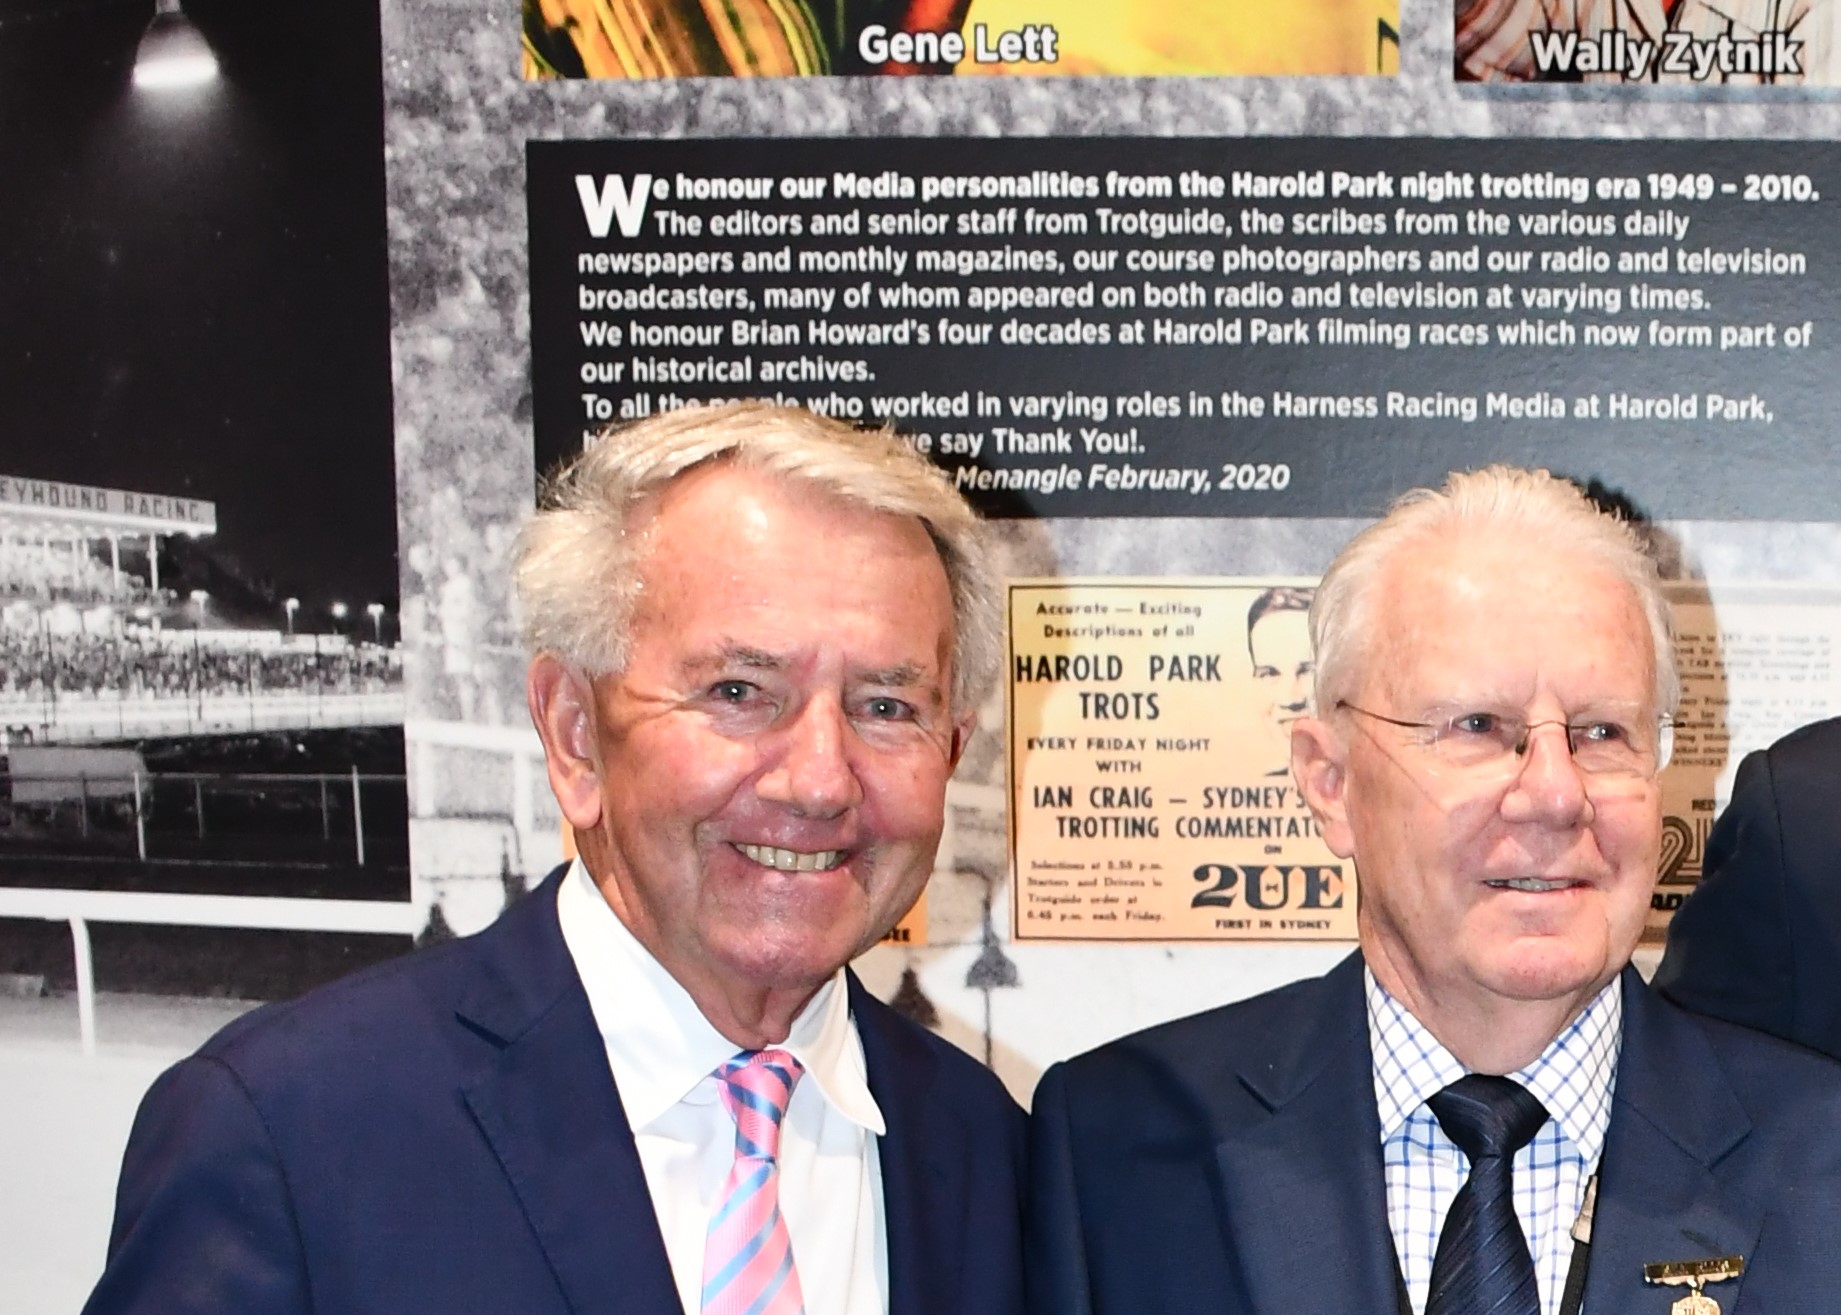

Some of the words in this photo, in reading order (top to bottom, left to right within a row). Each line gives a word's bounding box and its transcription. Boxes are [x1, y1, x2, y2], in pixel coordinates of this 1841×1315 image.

[858, 24, 964, 64] Gene
[975, 24, 1058, 63] Lett
[1529, 31, 1652, 81] Wally
[1662, 31, 1801, 81] Zytnik
[574, 172, 669, 238] We
[675, 172, 774, 200] honour
[779, 177, 828, 199] our
[833, 171, 916, 199] Media
[921, 170, 1100, 203] personalities
[1105, 170, 1173, 198] from
[1178, 170, 1226, 198] the
[1231, 170, 1325, 198] Harold
[1331, 170, 1395, 198] Park
[1400, 170, 1475, 203] night
[1479, 171, 1590, 204] trotting
[1595, 177, 1642, 200] era
[1646, 172, 1715, 201] 1949
[1743, 173, 1820, 202] 2010.
[653, 210, 703, 236] The
[709, 209, 803, 236] editors
[810, 208, 860, 236] and
[867, 208, 950, 235] senior
[957, 207, 1017, 235] staff
[1024, 207, 1088, 235] from
[1095, 207, 1233, 239] Trotguide,
[1240, 207, 1285, 235] the
[1291, 207, 1387, 235] scribes
[1394, 207, 1459, 236] from
[1465, 208, 1511, 236] the
[1517, 208, 1617, 237] various
[1623, 209, 1690, 242] daily
[578, 251, 735, 277] newspapers
[741, 245, 791, 273] and
[798, 245, 908, 276] monthly
[916, 244, 1066, 276] magazines,
[1072, 249, 1119, 271] our
[1126, 249, 1216, 272] course
[1222, 244, 1422, 276] photographers
[1428, 244, 1480, 273] and
[1486, 250, 1534, 273] our
[1540, 245, 1611, 274] radio
[1617, 245, 1669, 274] and
[1676, 246, 1807, 276] television
[579, 284, 756, 311] broadcasters,
[764, 287, 836, 313] many
[843, 281, 871, 309] of
[878, 281, 960, 308] whom
[967, 281, 1094, 312] appeared
[1101, 286, 1136, 308] on
[1144, 281, 1207, 308] both
[1214, 281, 1284, 308] radio
[1290, 281, 1342, 308] and
[1349, 281, 1479, 309] television
[1485, 283, 1514, 309] at
[1520, 281, 1622, 315] varying
[1629, 282, 1712, 312] times.
[580, 321, 622, 346] We
[630, 321, 724, 346] honour
[732, 319, 800, 346] Brian
[808, 318, 931, 345] Howard's
[938, 318, 993, 344] four
[1000, 318, 1111, 345] decades
[1118, 319, 1145, 345] at
[1153, 317, 1242, 345] Harold
[1250, 317, 1310, 345] Park
[1317, 317, 1411, 349] filming
[1419, 323, 1490, 346] races
[1496, 318, 1576, 346] which
[1583, 324, 1641, 347] now
[1648, 319, 1713, 348] form
[1719, 322, 1777, 353] part
[1783, 320, 1814, 351] of
[580, 362, 625, 383] our
[632, 355, 752, 383] historical
[759, 355, 876, 382] archives.
[582, 394, 612, 419] To
[619, 394, 650, 419] all
[807, 392, 864, 418] who
[871, 391, 969, 418] worked
[977, 391, 1001, 416] in
[1009, 391, 1108, 422] varying
[1116, 390, 1182, 417] roles
[1189, 390, 1213, 417] in
[1221, 390, 1265, 418] the
[1273, 391, 1379, 418] Harness
[1386, 391, 1478, 423] Racing
[1485, 391, 1566, 419] Media
[1573, 393, 1601, 419] at
[1608, 391, 1699, 422] Harold
[1705, 392, 1775, 426] Park,
[940, 432, 984, 458] say
[991, 427, 1073, 454] Thank
[1079, 427, 1146, 454] You!.
[955, 463, 1082, 495] Menangle
[1087, 463, 1212, 495] February,
[1217, 463, 1291, 491] 2020
[123, 491, 200, 523] RACING
[1035, 601, 1109, 615] Accurate
[1139, 601, 1203, 618] Exciting
[1043, 623, 1143, 640] Descriptions
[1153, 624, 1168, 638] of
[1174, 624, 1195, 638] all
[1016, 654, 1123, 683] HAROLD
[1150, 655, 1221, 681] PARK
[1079, 692, 1159, 720] TROTS
[1026, 737, 1076, 751] EVERY
[1086, 737, 1146, 751] FRIDAY
[1156, 739, 1210, 751] NIGHT
[1096, 760, 1142, 773] WITH
[1034, 786, 1073, 808] IAN
[1089, 786, 1153, 809] CRAIG
[1057, 816, 1159, 838] TROTTING
[1190, 863, 1343, 911] 2UE
[1215, 919, 1252, 930] FIRST
[1259, 919, 1273, 929] IN
[1279, 919, 1331, 930] SYDNEY
